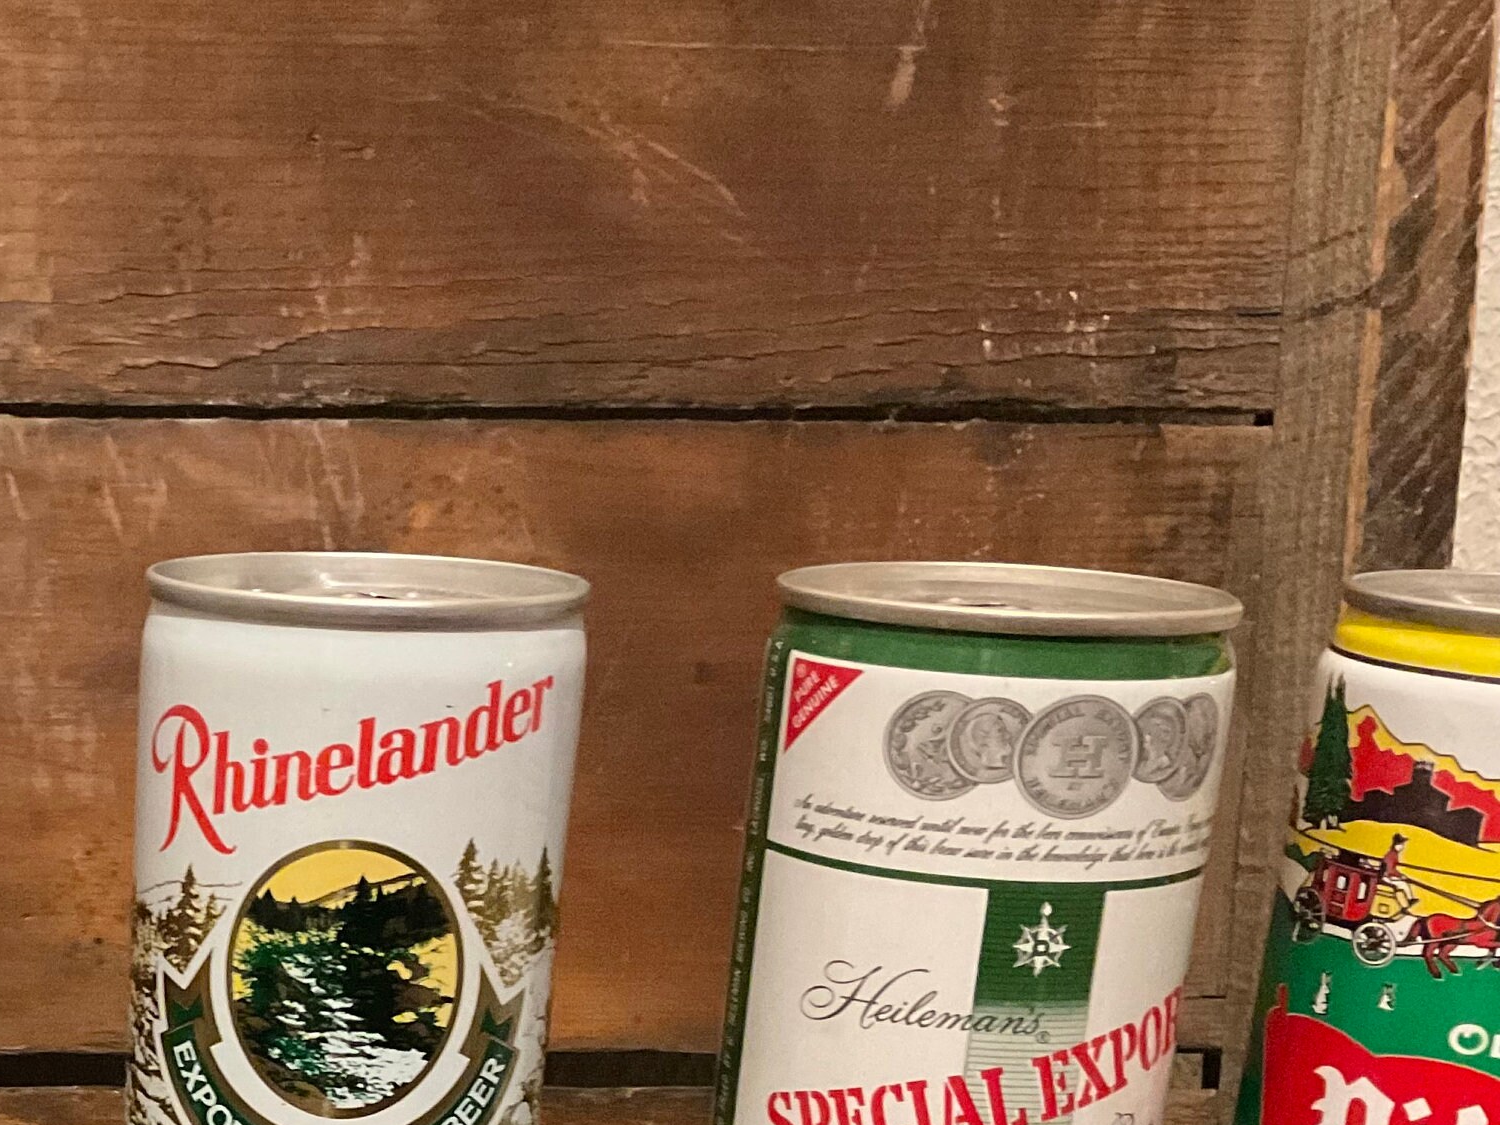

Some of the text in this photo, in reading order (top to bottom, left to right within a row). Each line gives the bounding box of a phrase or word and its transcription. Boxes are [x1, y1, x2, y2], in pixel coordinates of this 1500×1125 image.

[791, 674, 840, 729] GENUINE
[152, 675, 555, 856] Rhinelander
[800, 960, 1041, 1031] Heileman's
